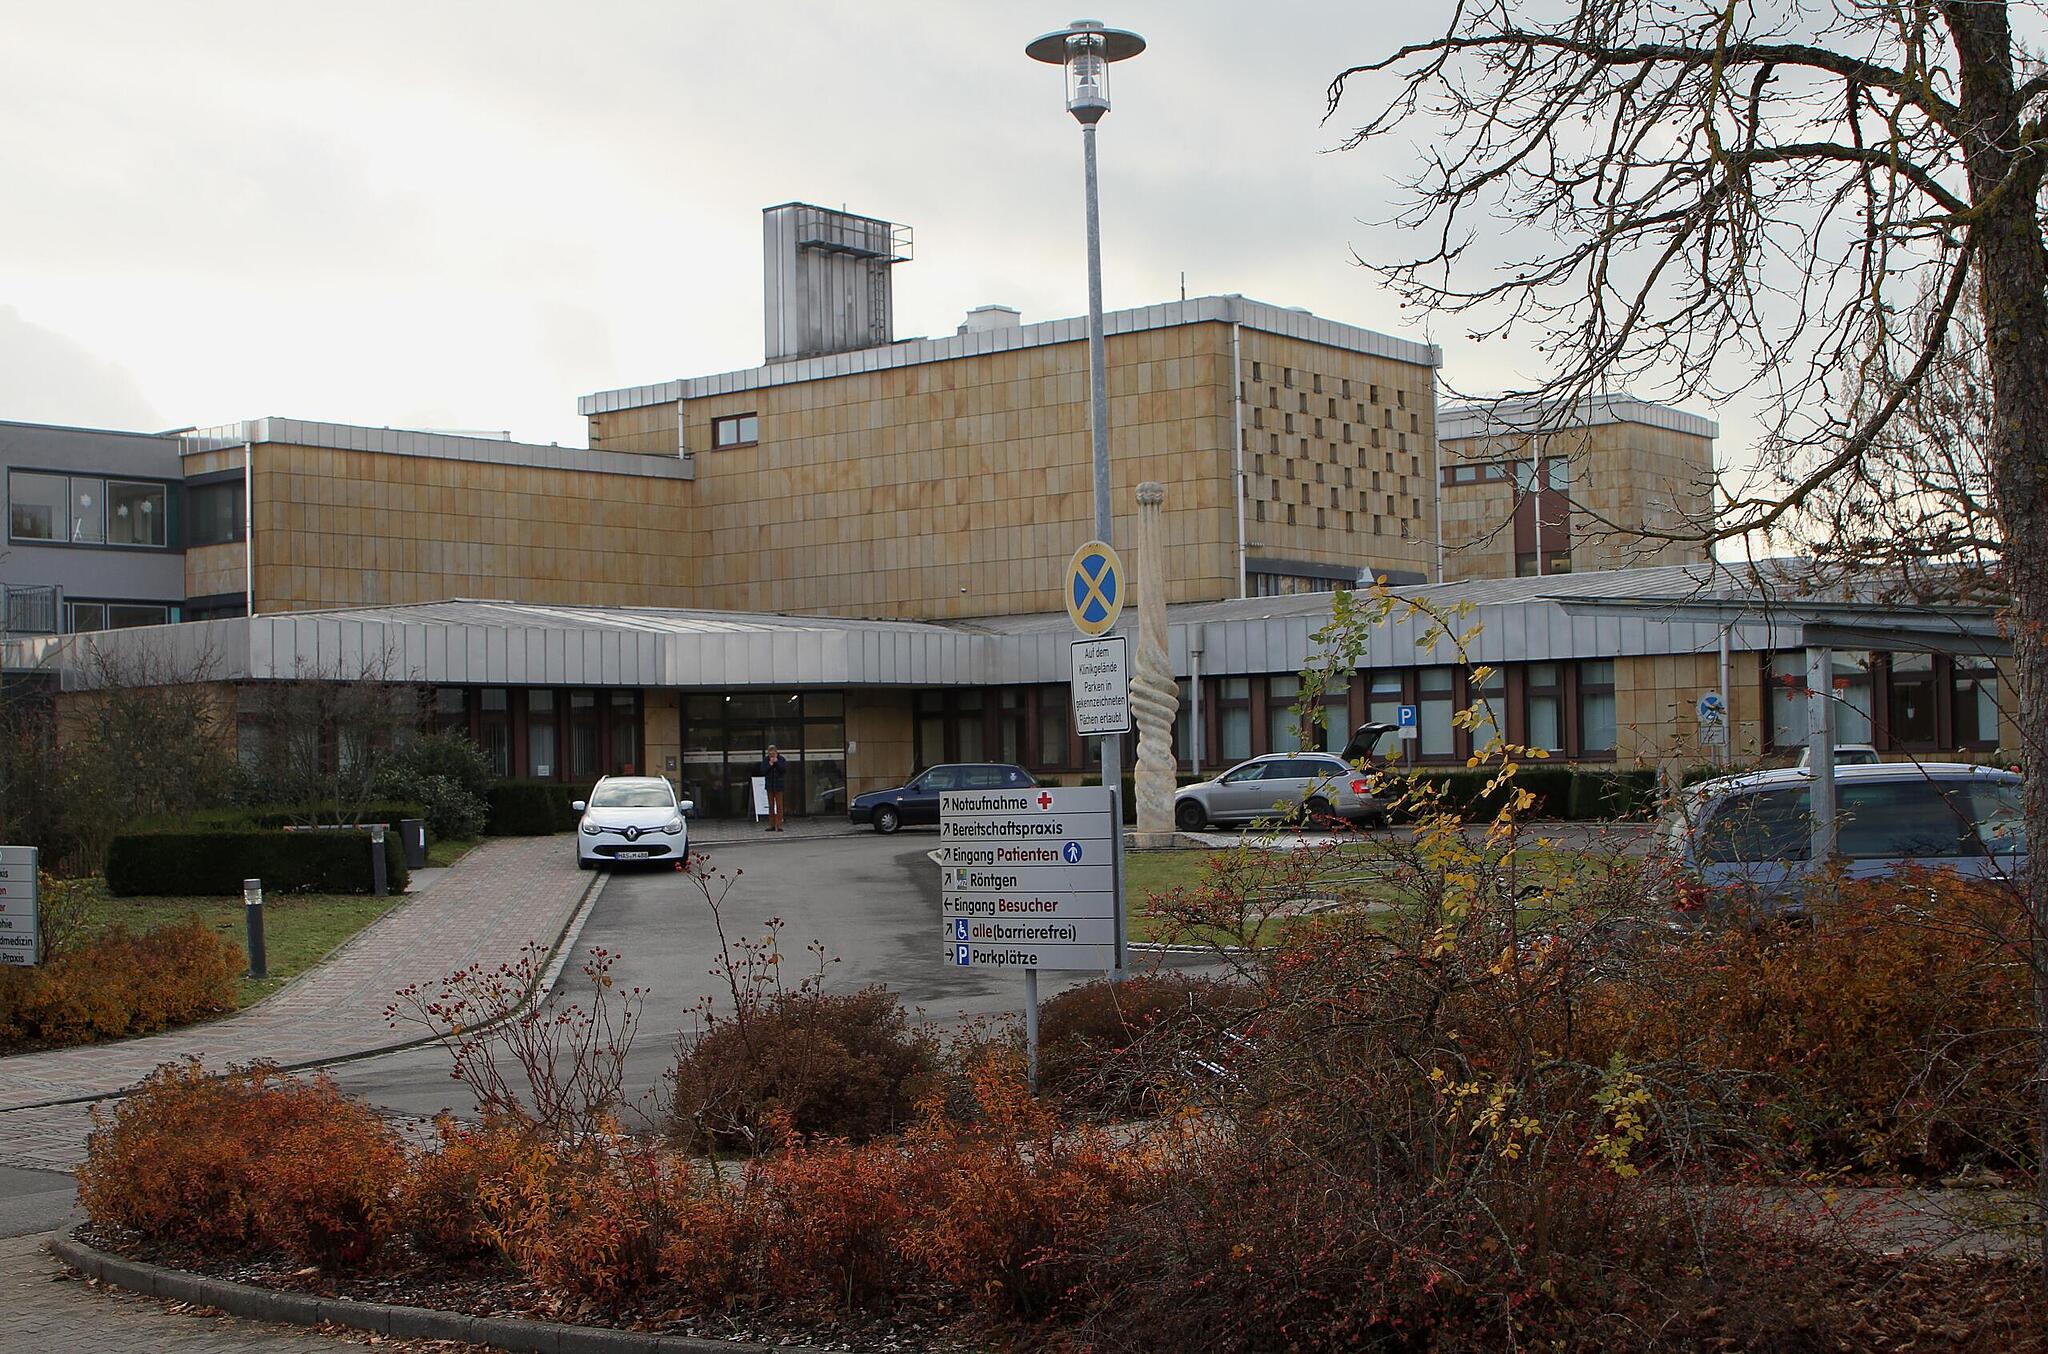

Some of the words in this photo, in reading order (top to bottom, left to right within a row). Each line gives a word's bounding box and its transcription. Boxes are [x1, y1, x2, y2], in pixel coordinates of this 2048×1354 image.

[1084, 647, 1095, 659] Auf
[1095, 646, 1110, 658] dem
[1079, 661, 1118, 677] Klinikgelände
[1084, 681, 1105, 693] Parken
[1105, 680, 1112, 691] in
[1076, 695, 1126, 712] gekennzeichneten
[1079, 714, 1099, 726] Flächen
[951, 795, 1028, 811] Notaufnahme
[952, 819, 1063, 838] Bereitschaftspraxis
[953, 849, 994, 865] Eingang
[997, 847, 1059, 862] Patienten
[970, 872, 1017, 890] Röntgen
[954, 896, 996, 915] Eingang
[998, 897, 1059, 912] Besucher
[2, 952, 25, 963] Praxis
[972, 949, 1038, 967] Parkplätze
